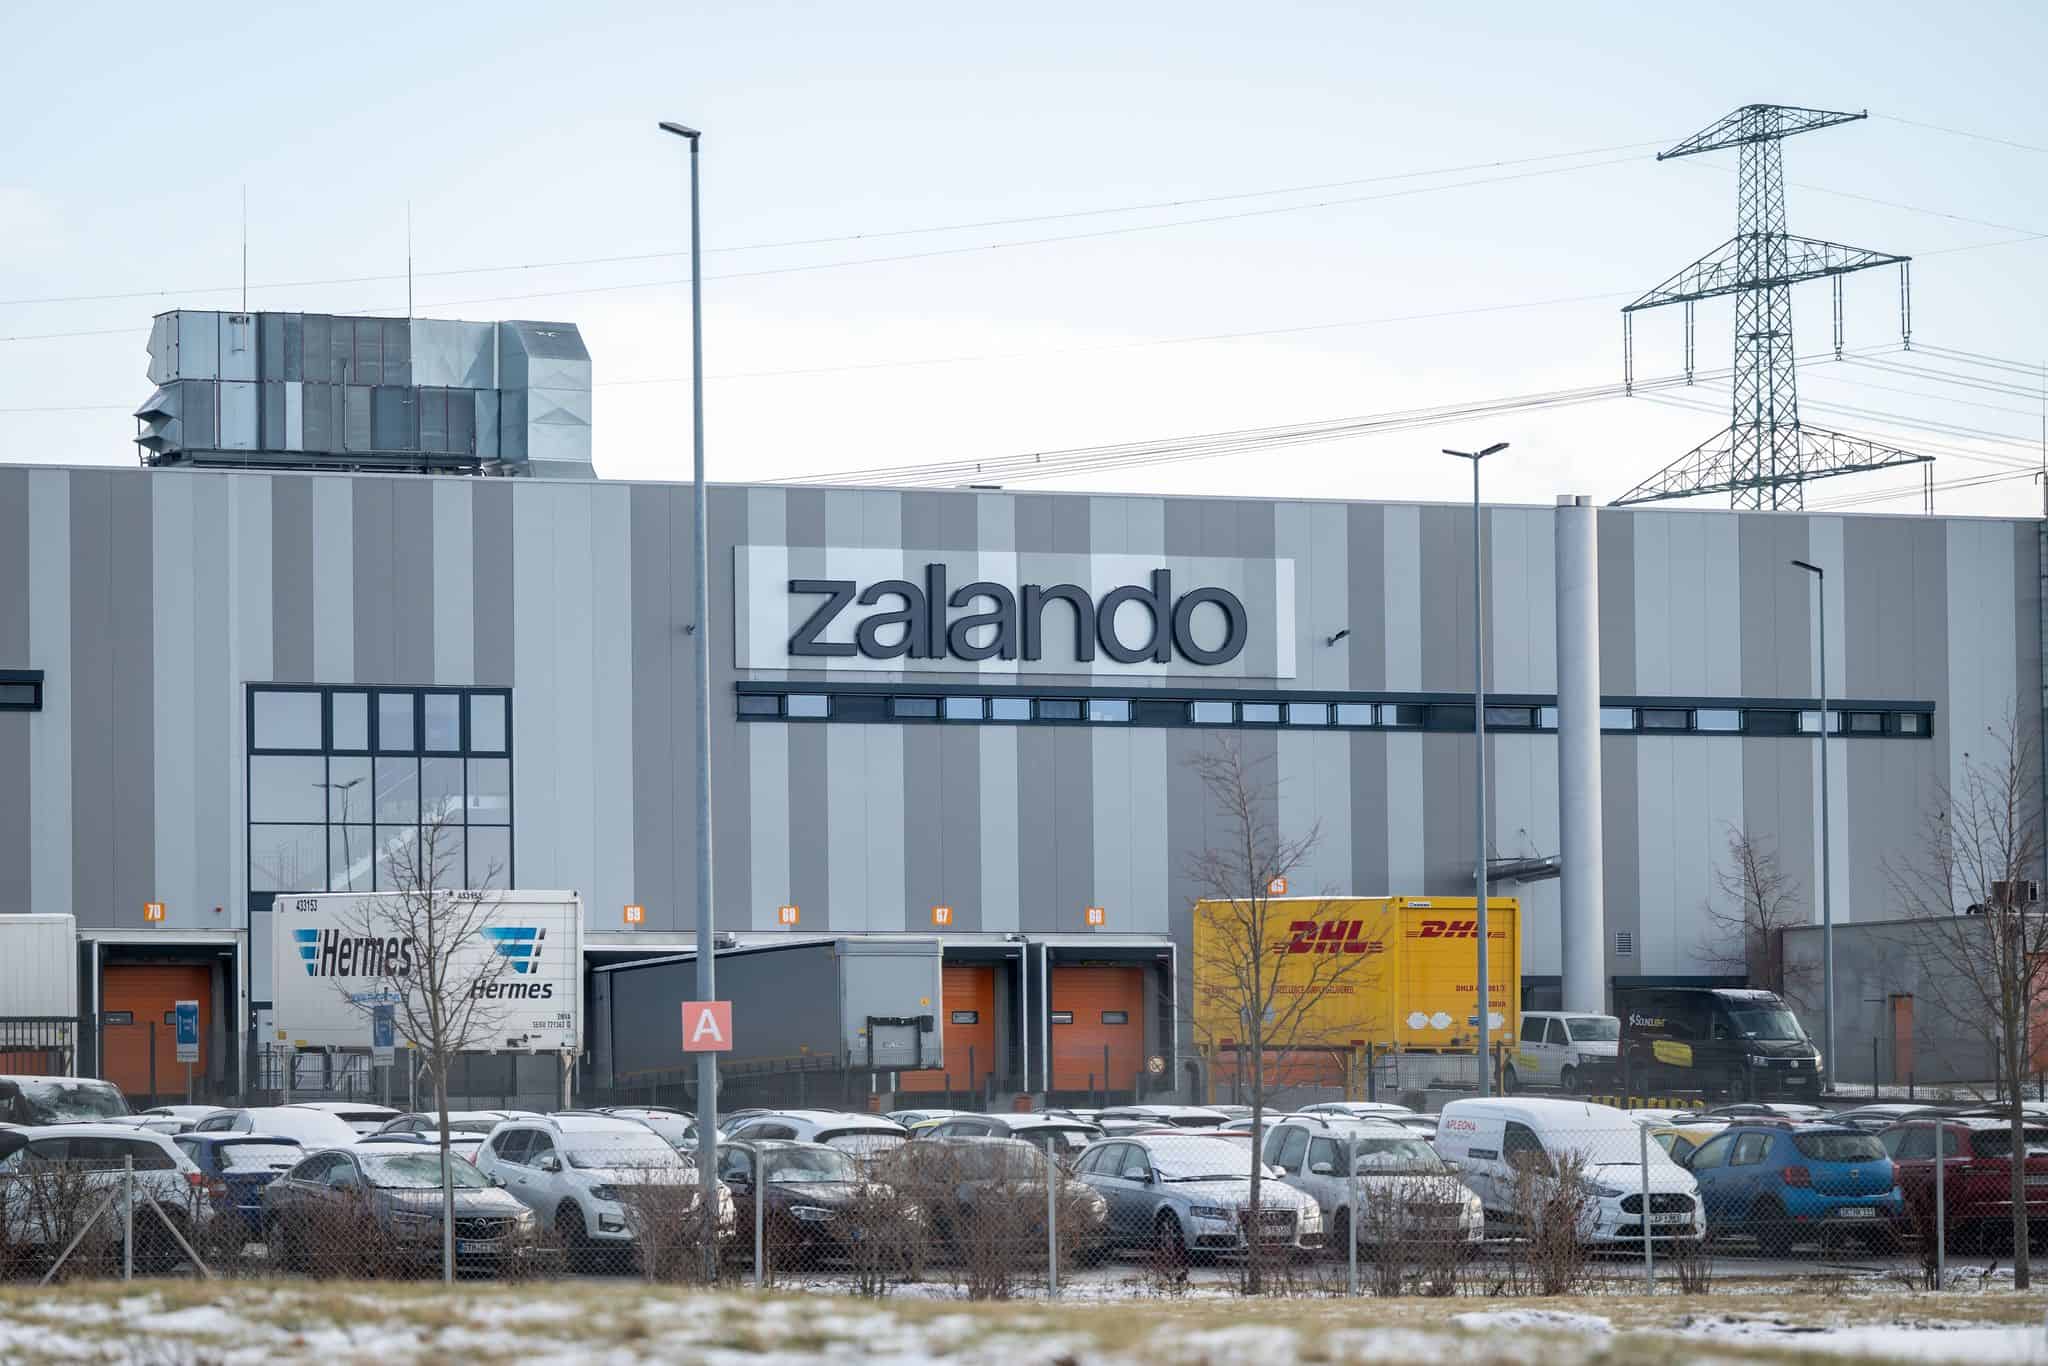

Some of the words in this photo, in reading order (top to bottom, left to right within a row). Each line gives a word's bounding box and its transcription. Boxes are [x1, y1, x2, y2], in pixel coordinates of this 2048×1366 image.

[788, 563, 1248, 666] zalando
[148, 904, 162, 920] 70
[296, 899, 318, 912] 433153
[320, 928, 413, 977] Hermes
[1286, 919, 1370, 954] DHL
[470, 981, 553, 999] Hermes
[692, 1008, 722, 1042] A
